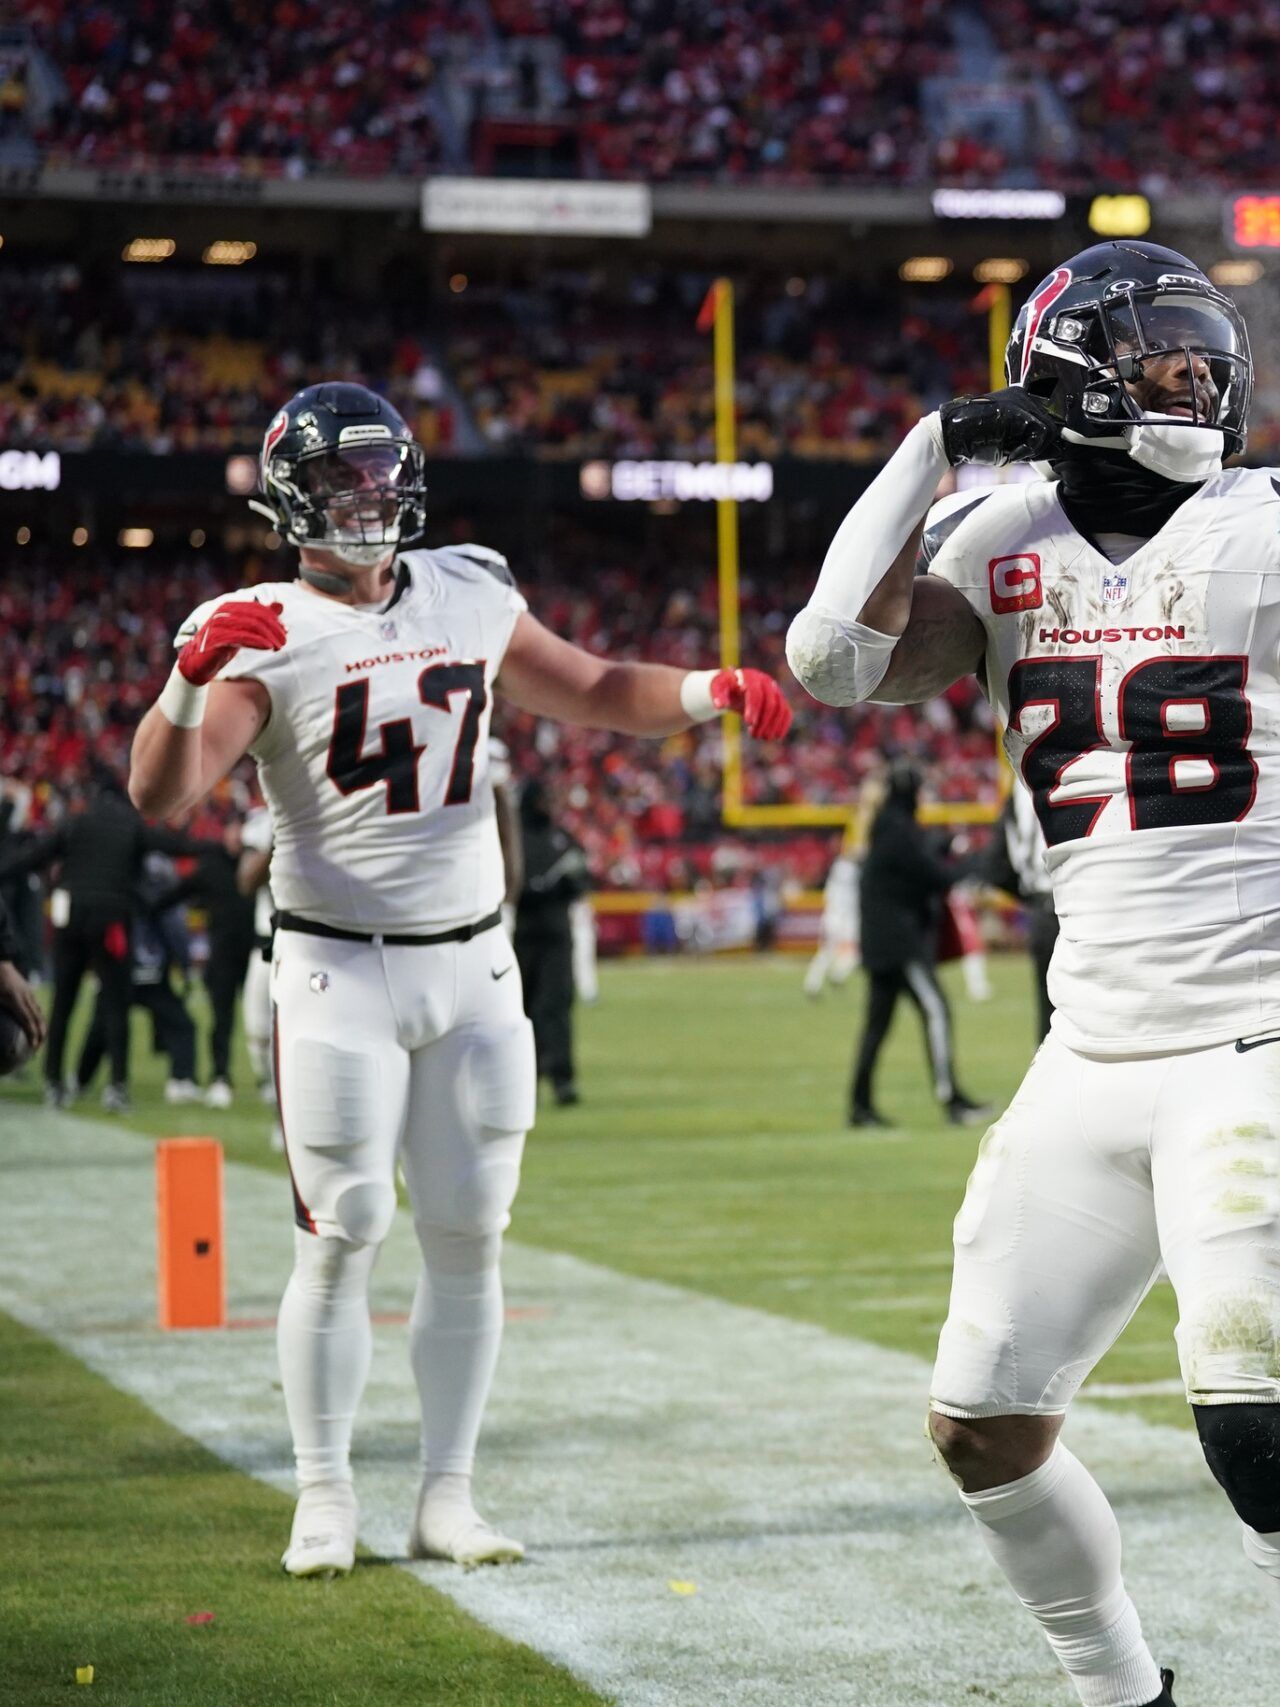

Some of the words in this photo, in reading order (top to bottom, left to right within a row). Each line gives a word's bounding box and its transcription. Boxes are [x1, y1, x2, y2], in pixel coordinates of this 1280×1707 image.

[993, 557, 1039, 598] C
[1039, 625, 1185, 644] HOUSTON
[345, 646, 449, 673] HOUSTON
[327, 659, 487, 815] 47
[1008, 655, 1259, 848] 28
